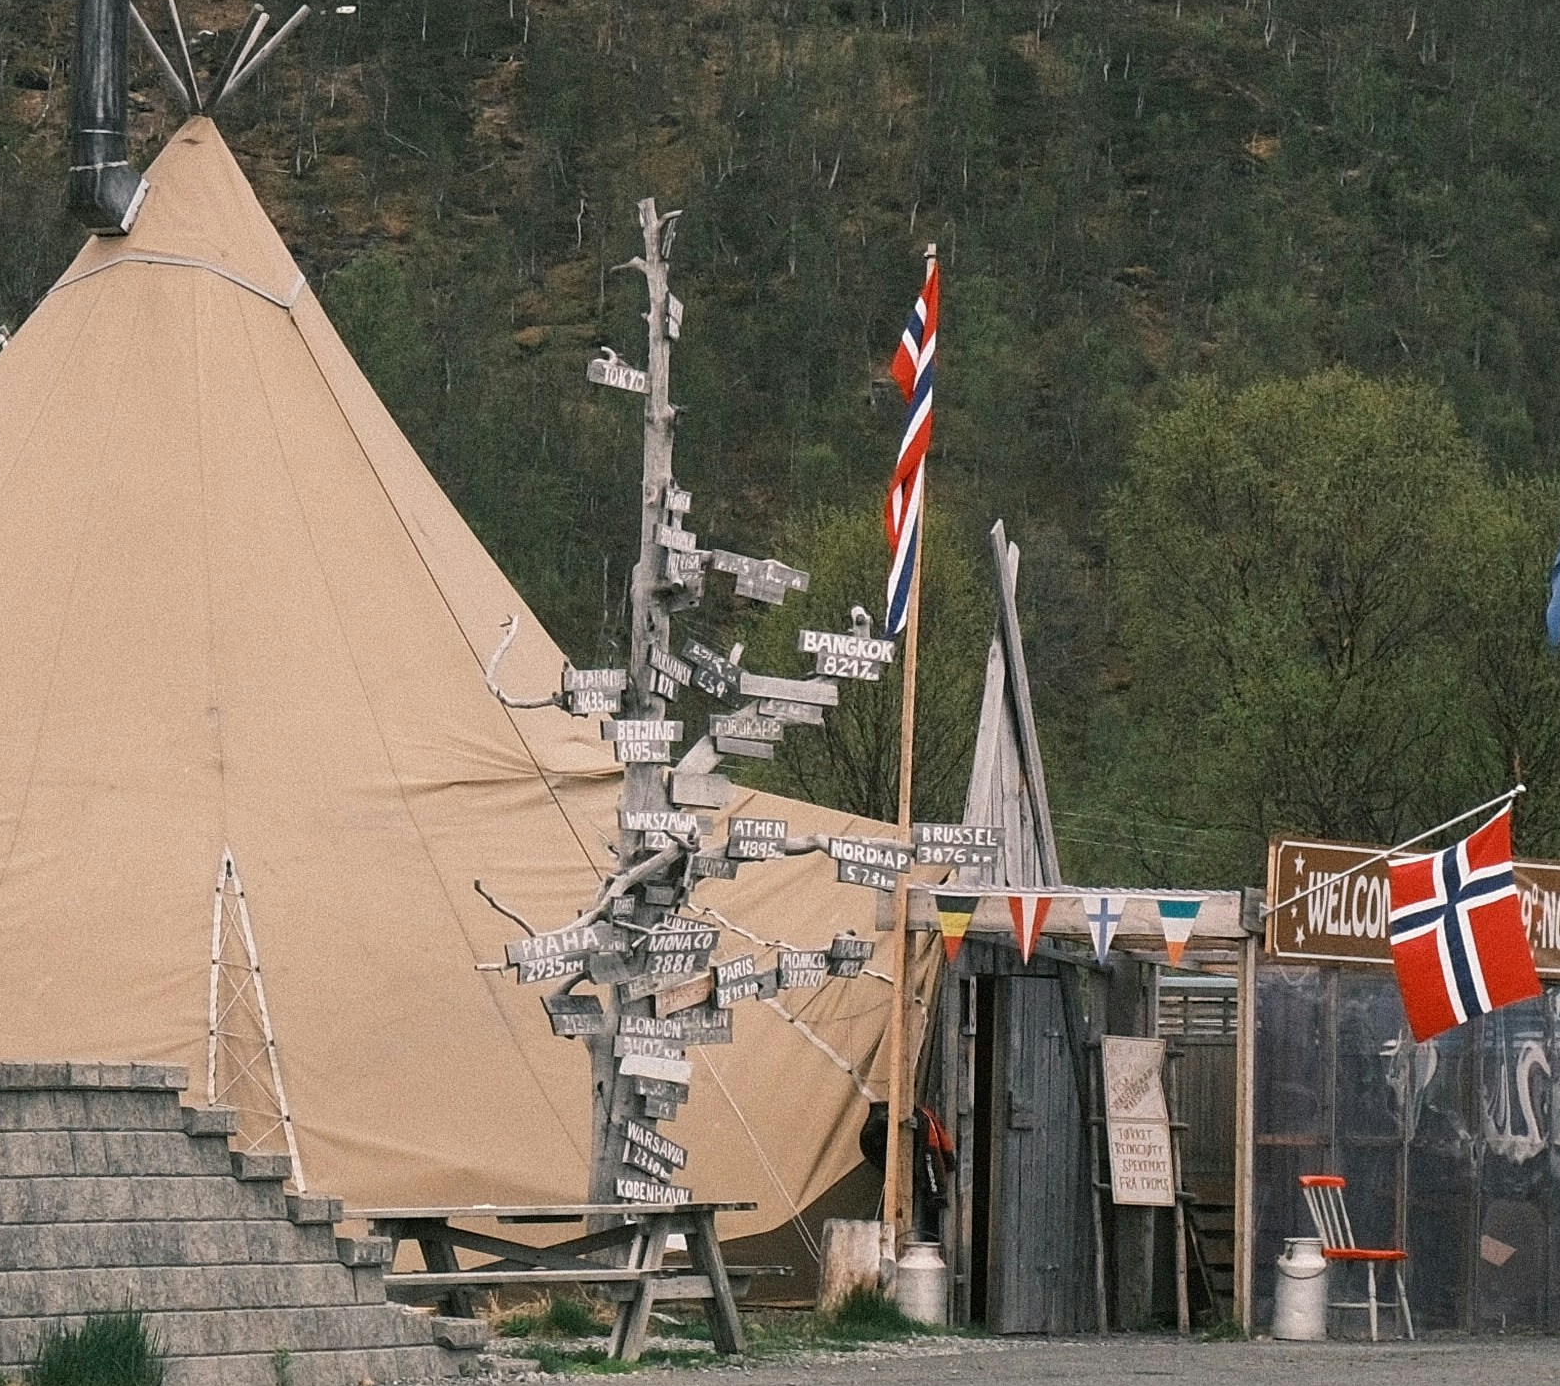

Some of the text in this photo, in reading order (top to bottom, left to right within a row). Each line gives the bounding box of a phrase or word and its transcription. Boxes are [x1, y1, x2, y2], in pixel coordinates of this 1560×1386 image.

[603, 363, 646, 391] TOKYO
[804, 632, 894, 663] BANGKOK
[617, 720, 676, 741] BEIJING
[626, 812, 698, 832] WARSZAWA
[734, 819, 786, 839] ATHEN
[921, 848, 966, 865] 3076
[522, 927, 599, 959] PRAHA
[648, 933, 713, 952] MONACO
[651, 954, 696, 974] 3888
[719, 958, 754, 986] PARIS
[625, 1015, 681, 1039] LONDON
[628, 1120, 685, 1168] WARSAWA
